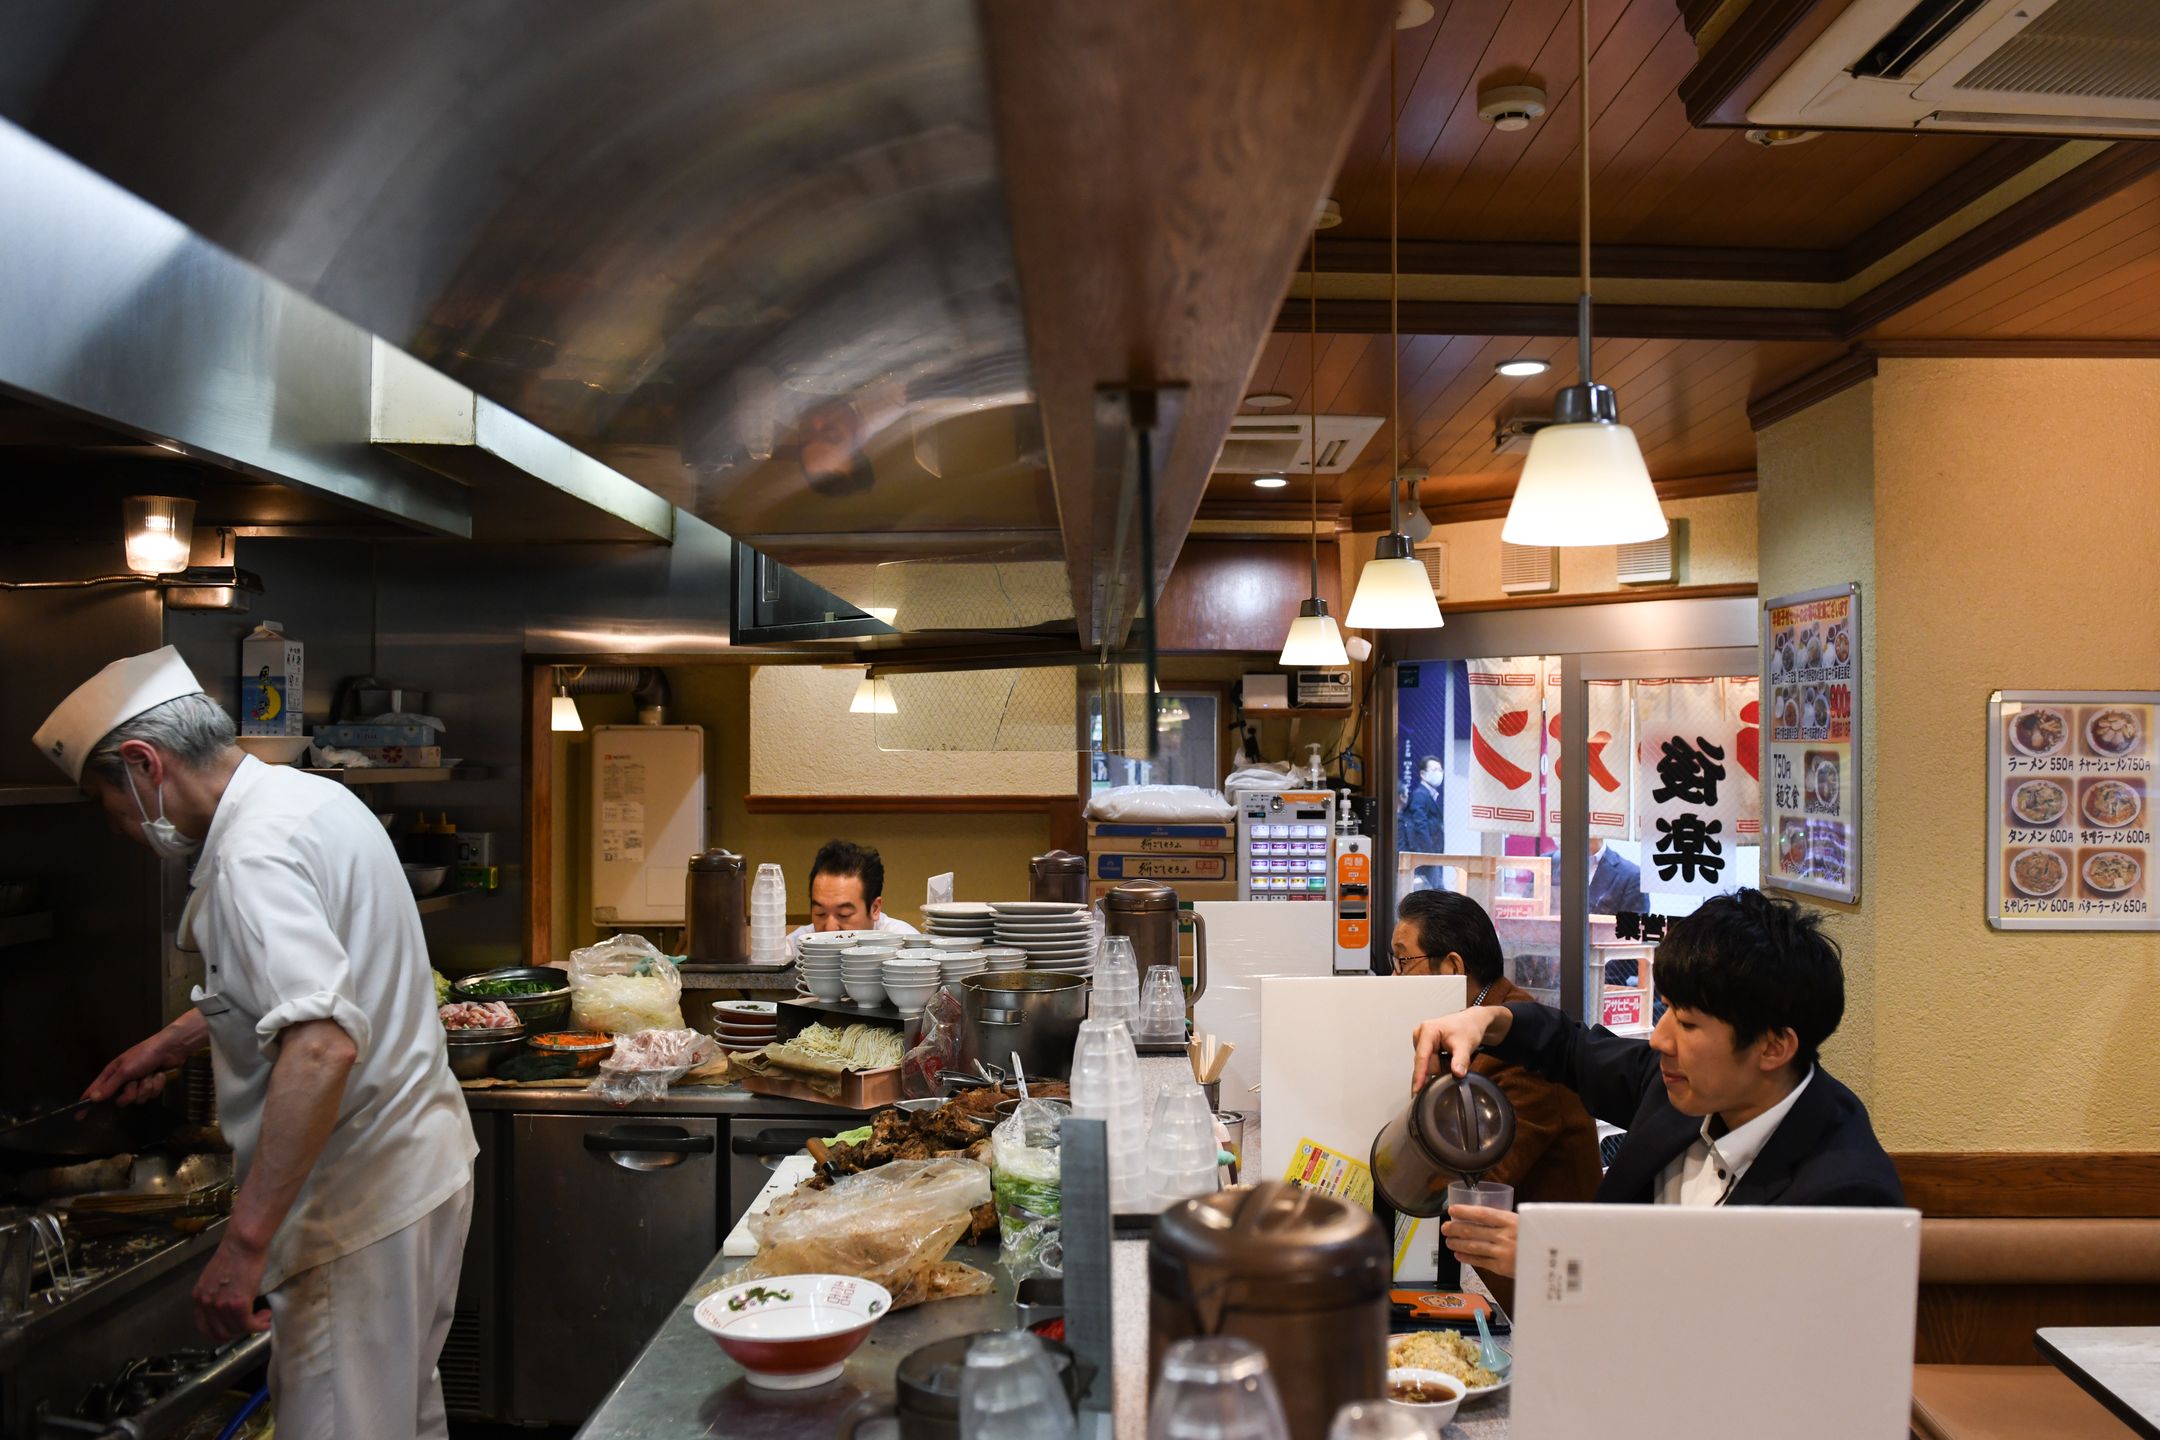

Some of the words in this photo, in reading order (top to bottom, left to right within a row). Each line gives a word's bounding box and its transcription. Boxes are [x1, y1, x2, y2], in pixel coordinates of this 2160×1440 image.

[1773, 753, 1792, 779] 750円
[2008, 757, 2048, 772] ラーメン
[2050, 757, 2074, 771] 550円
[2008, 829, 2047, 844] タンメン
[2050, 829, 2074, 843] 600円
[2004, 899, 2048, 913] もやしラーメン
[2050, 899, 2074, 913] 600円
[1603, 997, 1640, 1012] アサヒビール
